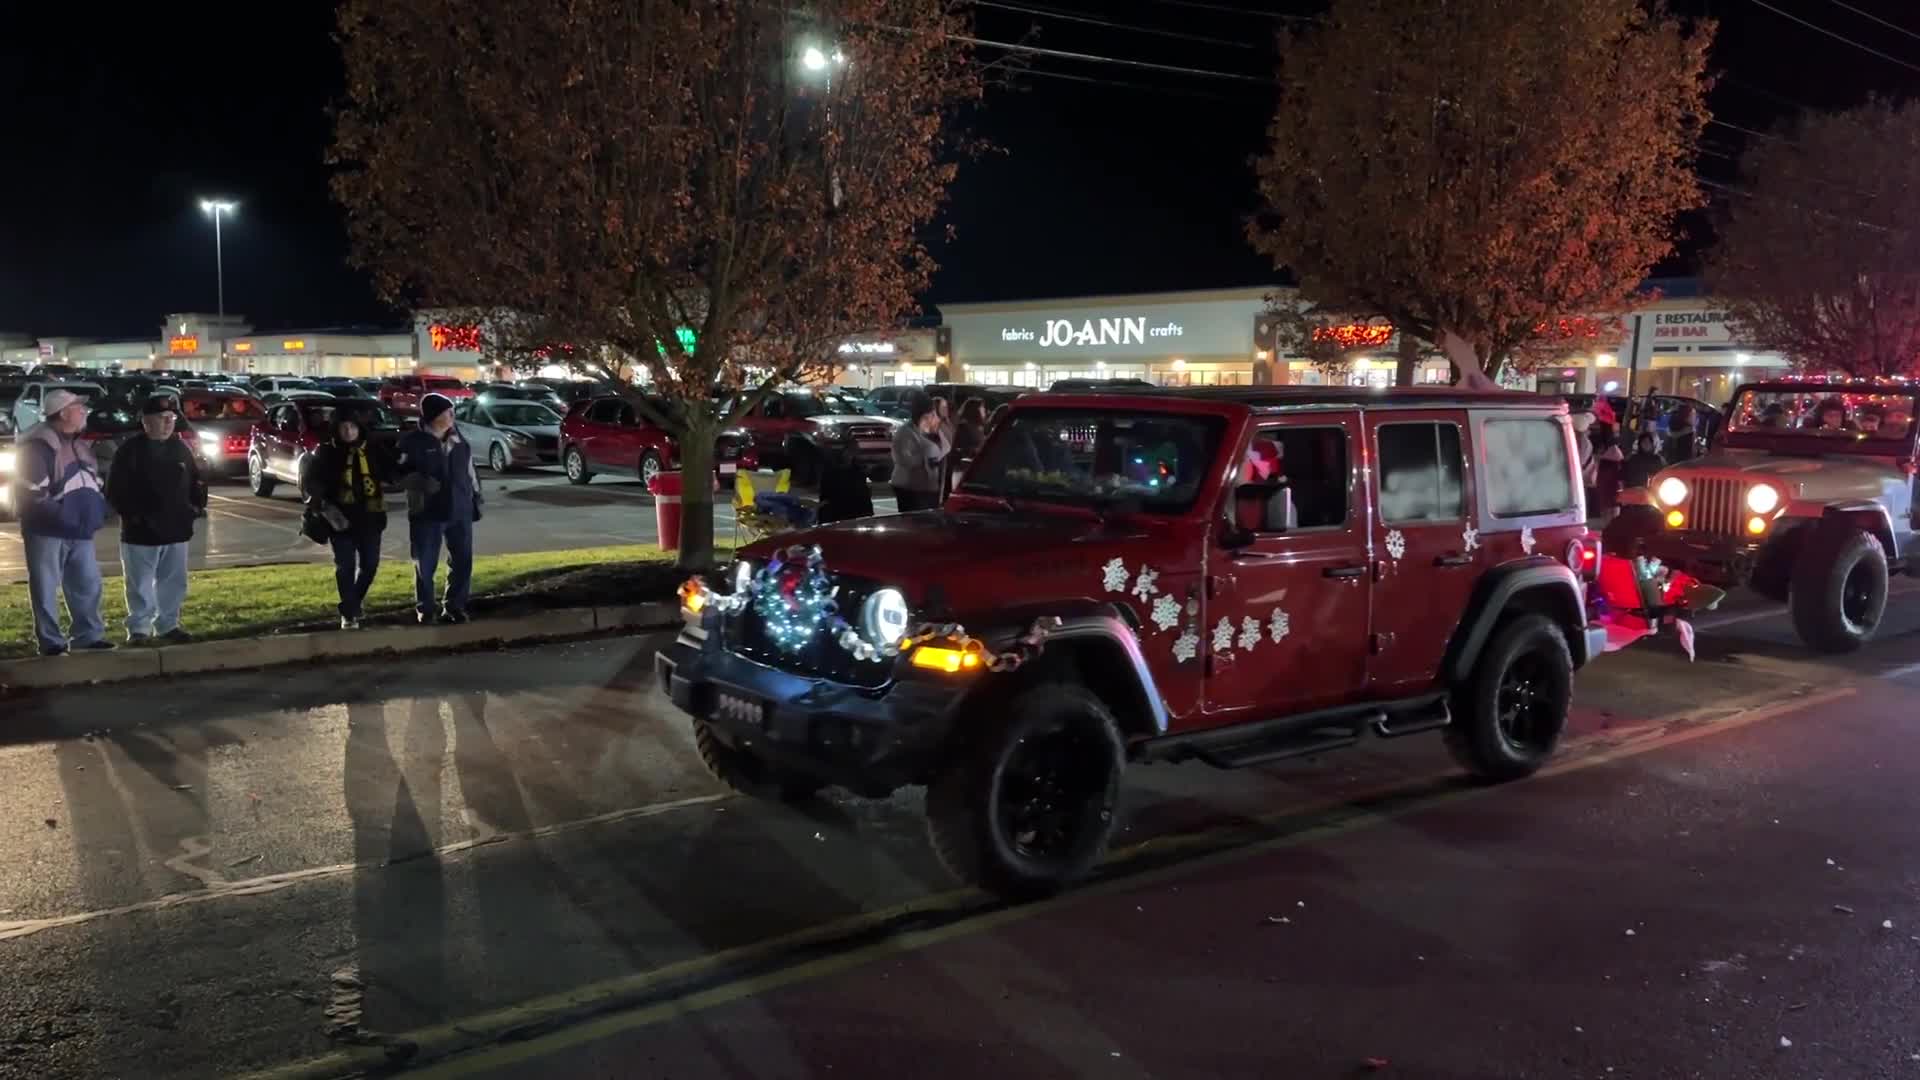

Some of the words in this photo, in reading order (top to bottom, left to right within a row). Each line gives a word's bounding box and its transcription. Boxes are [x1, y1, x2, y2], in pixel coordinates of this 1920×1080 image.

[1001, 328, 1034, 341] fabrics
[1149, 322, 1183, 337] crafts
[1682, 326, 1708, 337] BAR
